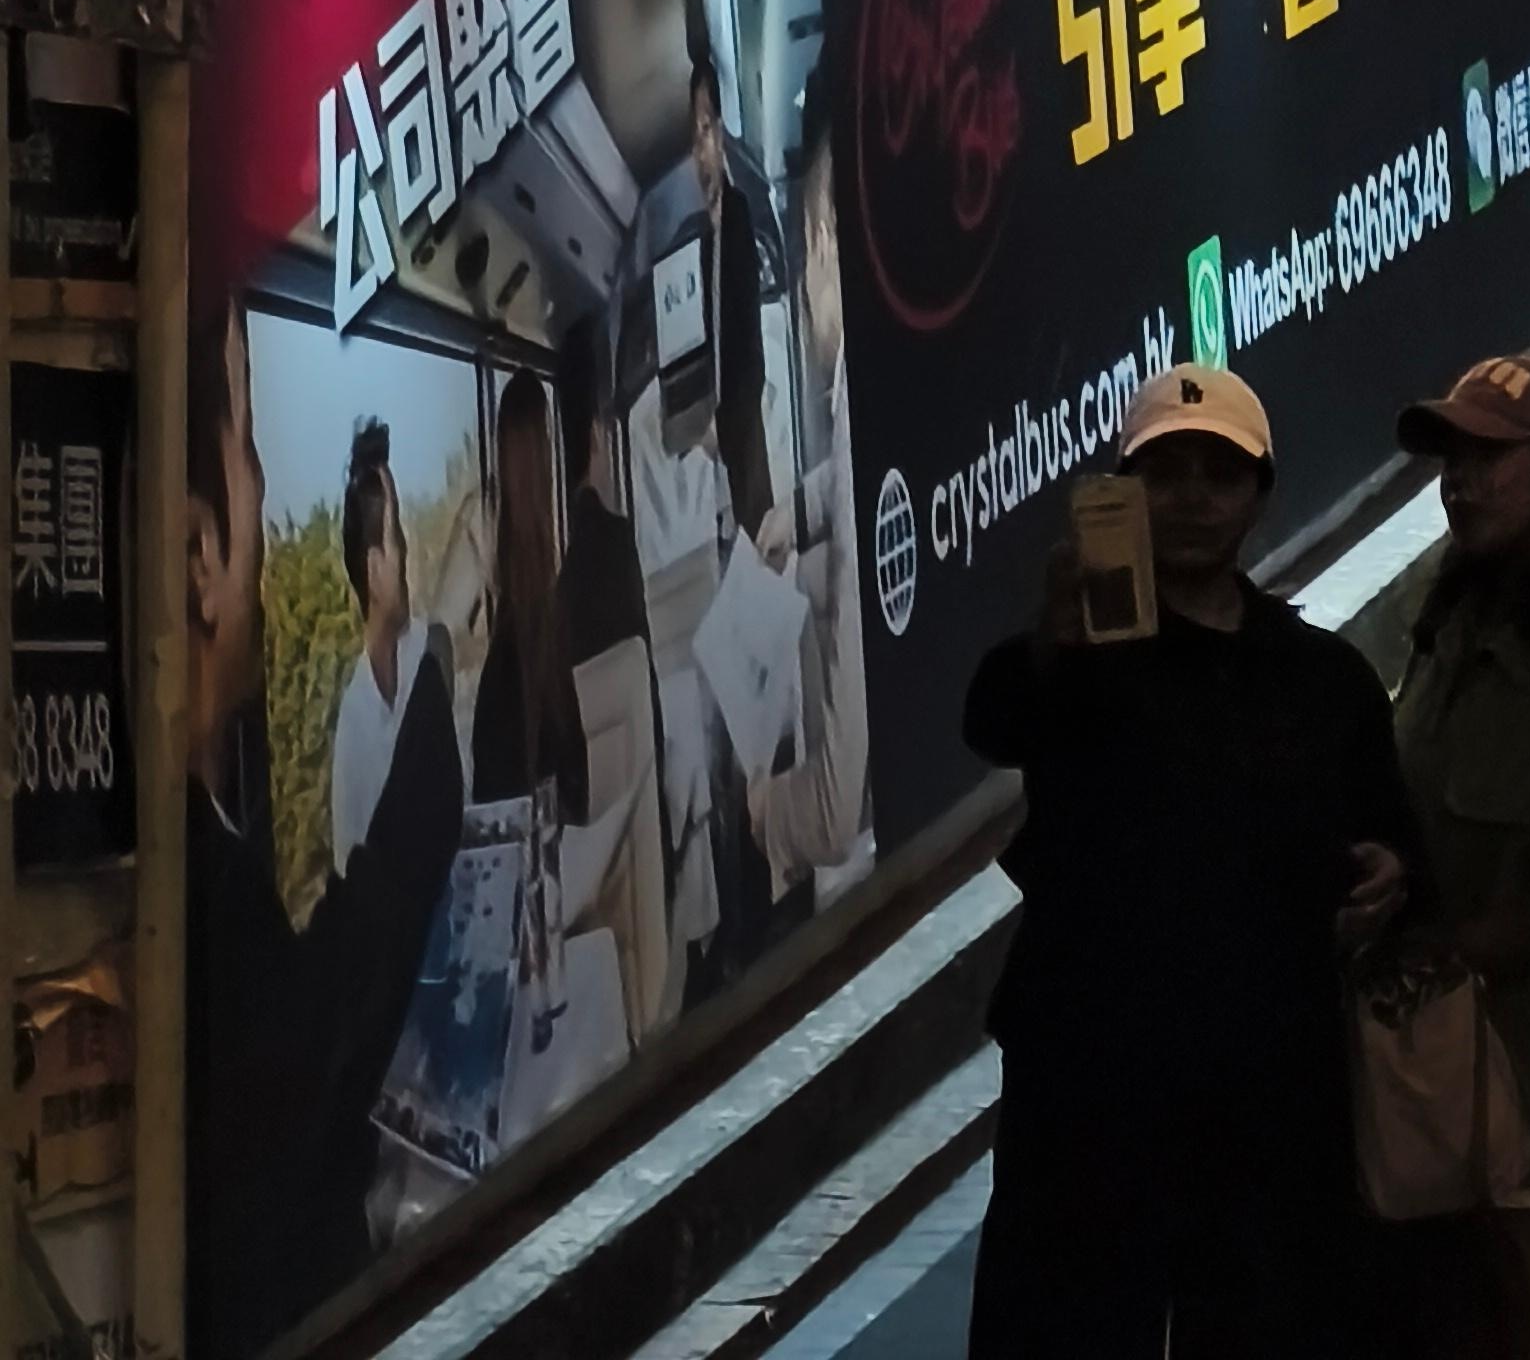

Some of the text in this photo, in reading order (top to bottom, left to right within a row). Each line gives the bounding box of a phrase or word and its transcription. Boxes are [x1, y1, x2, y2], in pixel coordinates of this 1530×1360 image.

[931, 305, 1174, 567] crystalbus.comhk
[1228, 227, 1334, 351] WhatsApp:
[1336, 126, 1452, 294] 69666348
[14, 441, 104, 600] 集團
[46, 693, 114, 792] 8348
